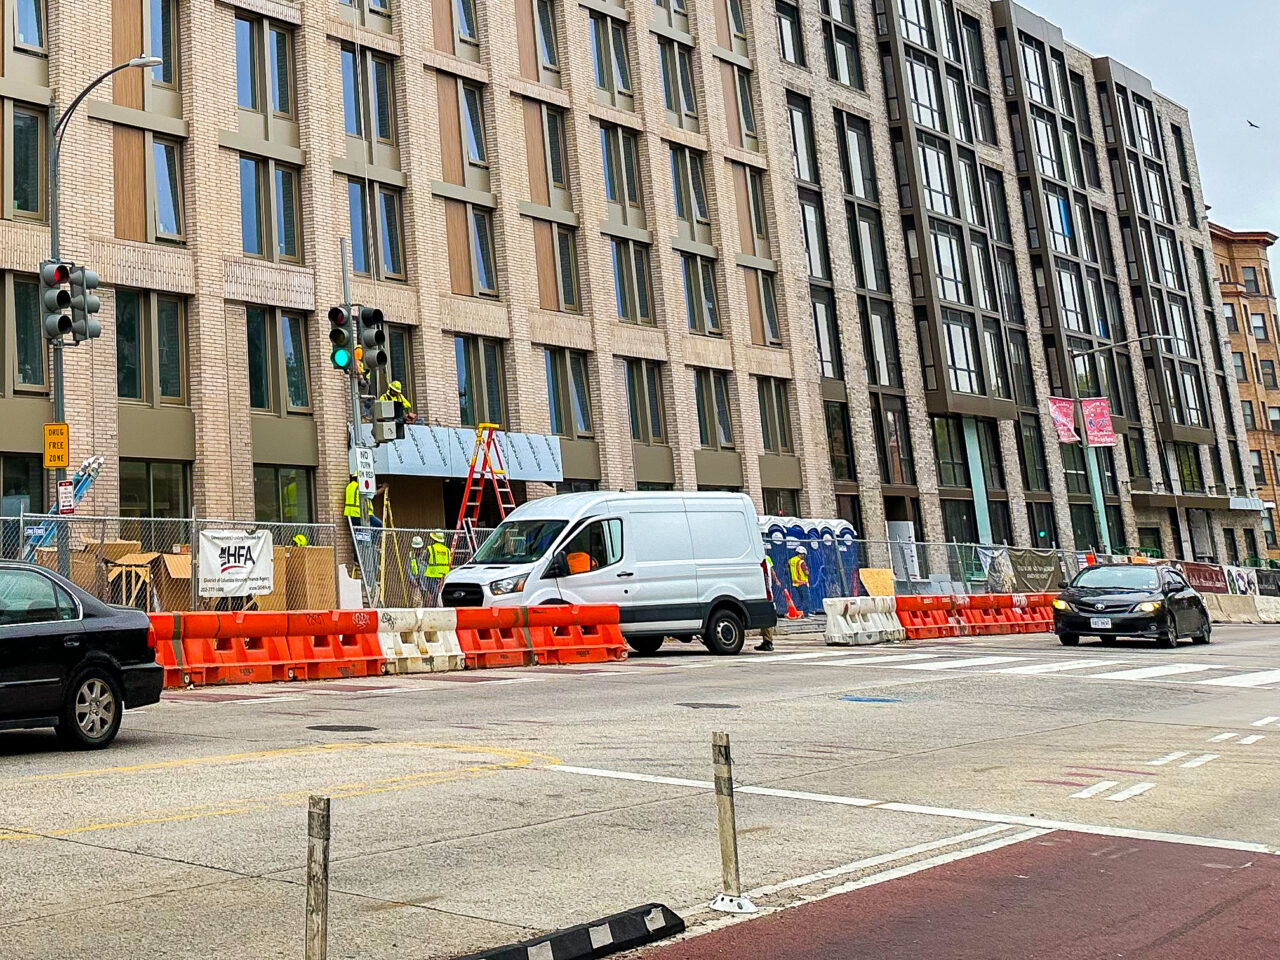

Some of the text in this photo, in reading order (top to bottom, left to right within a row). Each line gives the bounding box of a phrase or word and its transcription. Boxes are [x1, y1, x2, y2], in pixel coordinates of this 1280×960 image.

[48, 428, 64, 437] DRUG
[48, 441, 64, 450] FREE
[49, 454, 64, 463] ZONE
[360, 450, 369, 460] NO
[365, 470, 374, 479] RED
